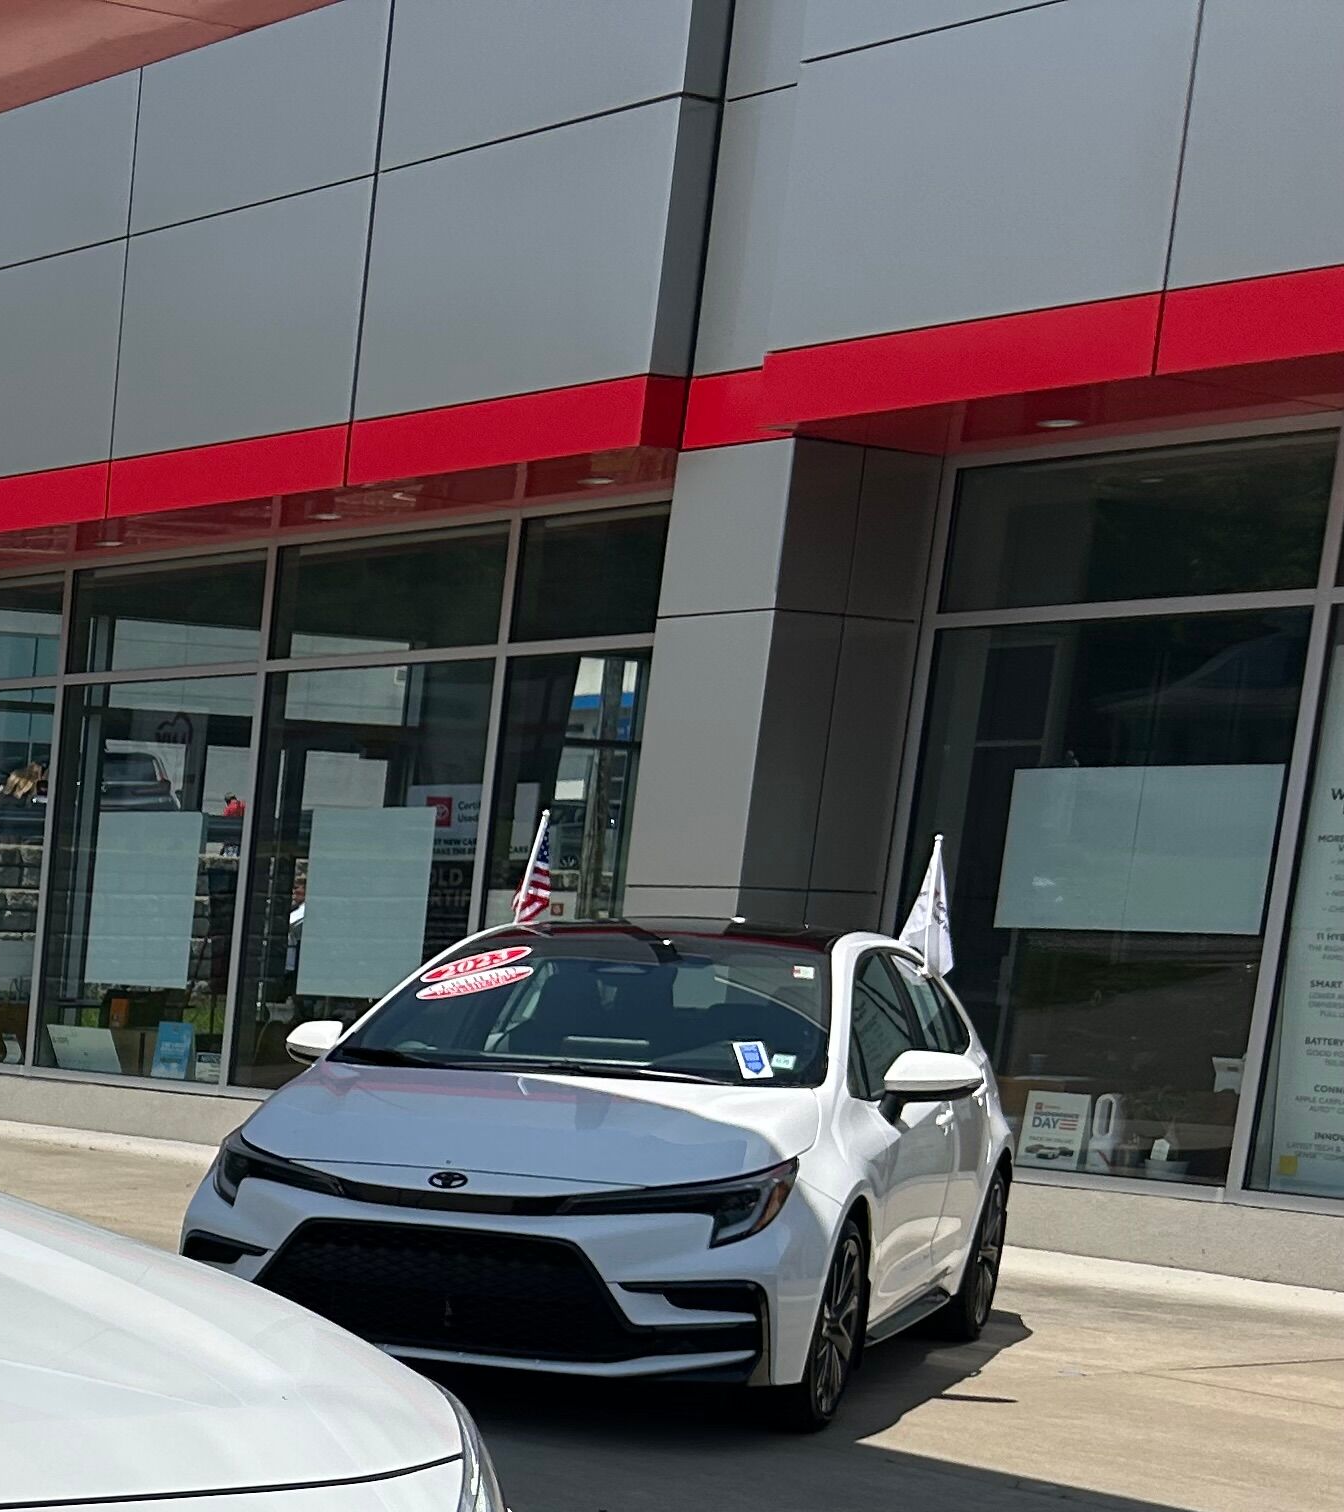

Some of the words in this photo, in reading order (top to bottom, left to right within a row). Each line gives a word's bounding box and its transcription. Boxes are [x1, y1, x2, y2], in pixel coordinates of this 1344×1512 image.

[458, 800, 481, 810] Certi
[1310, 980, 1343, 989] SMART
[1305, 1036, 1344, 1046] BATTERY
[1313, 1084, 1344, 1094] CONN
[1032, 1116, 1060, 1129] DAY
